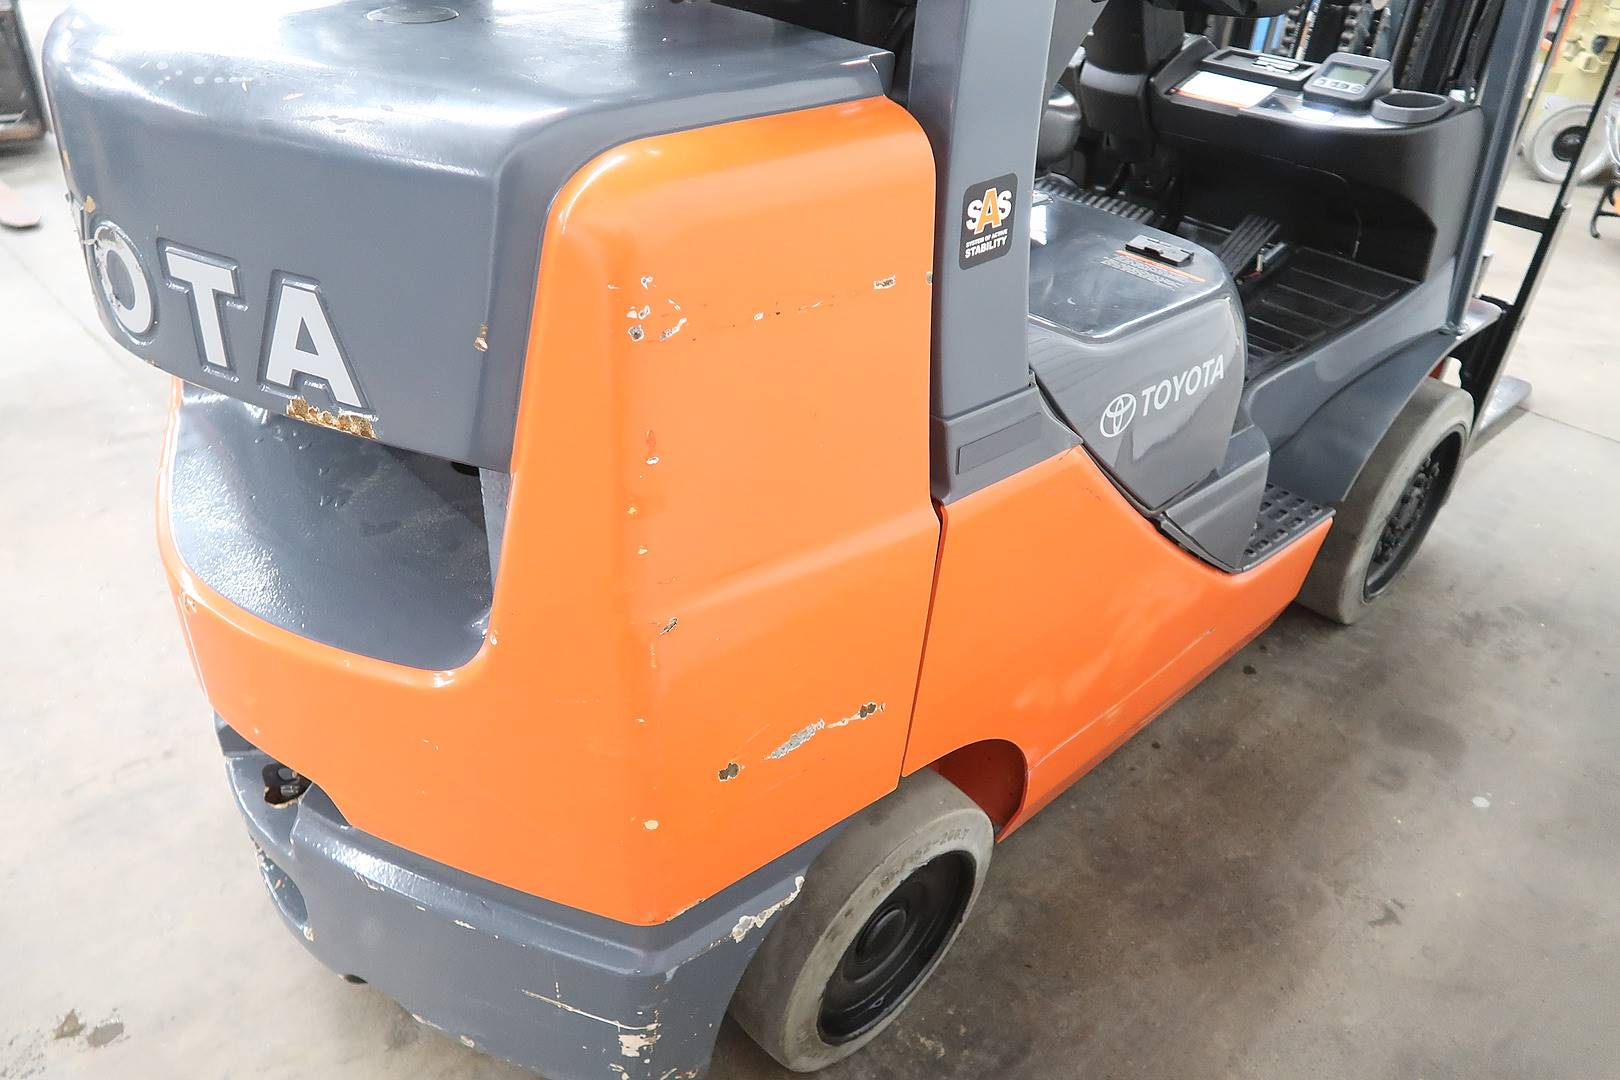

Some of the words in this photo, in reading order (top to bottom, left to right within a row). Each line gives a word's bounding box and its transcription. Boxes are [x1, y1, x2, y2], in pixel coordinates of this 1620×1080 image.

[965, 187, 1012, 235] SAS
[965, 235, 1008, 259] STABILITY
[985, 233, 992, 242] OF
[1141, 354, 1225, 417] TOYOTA
